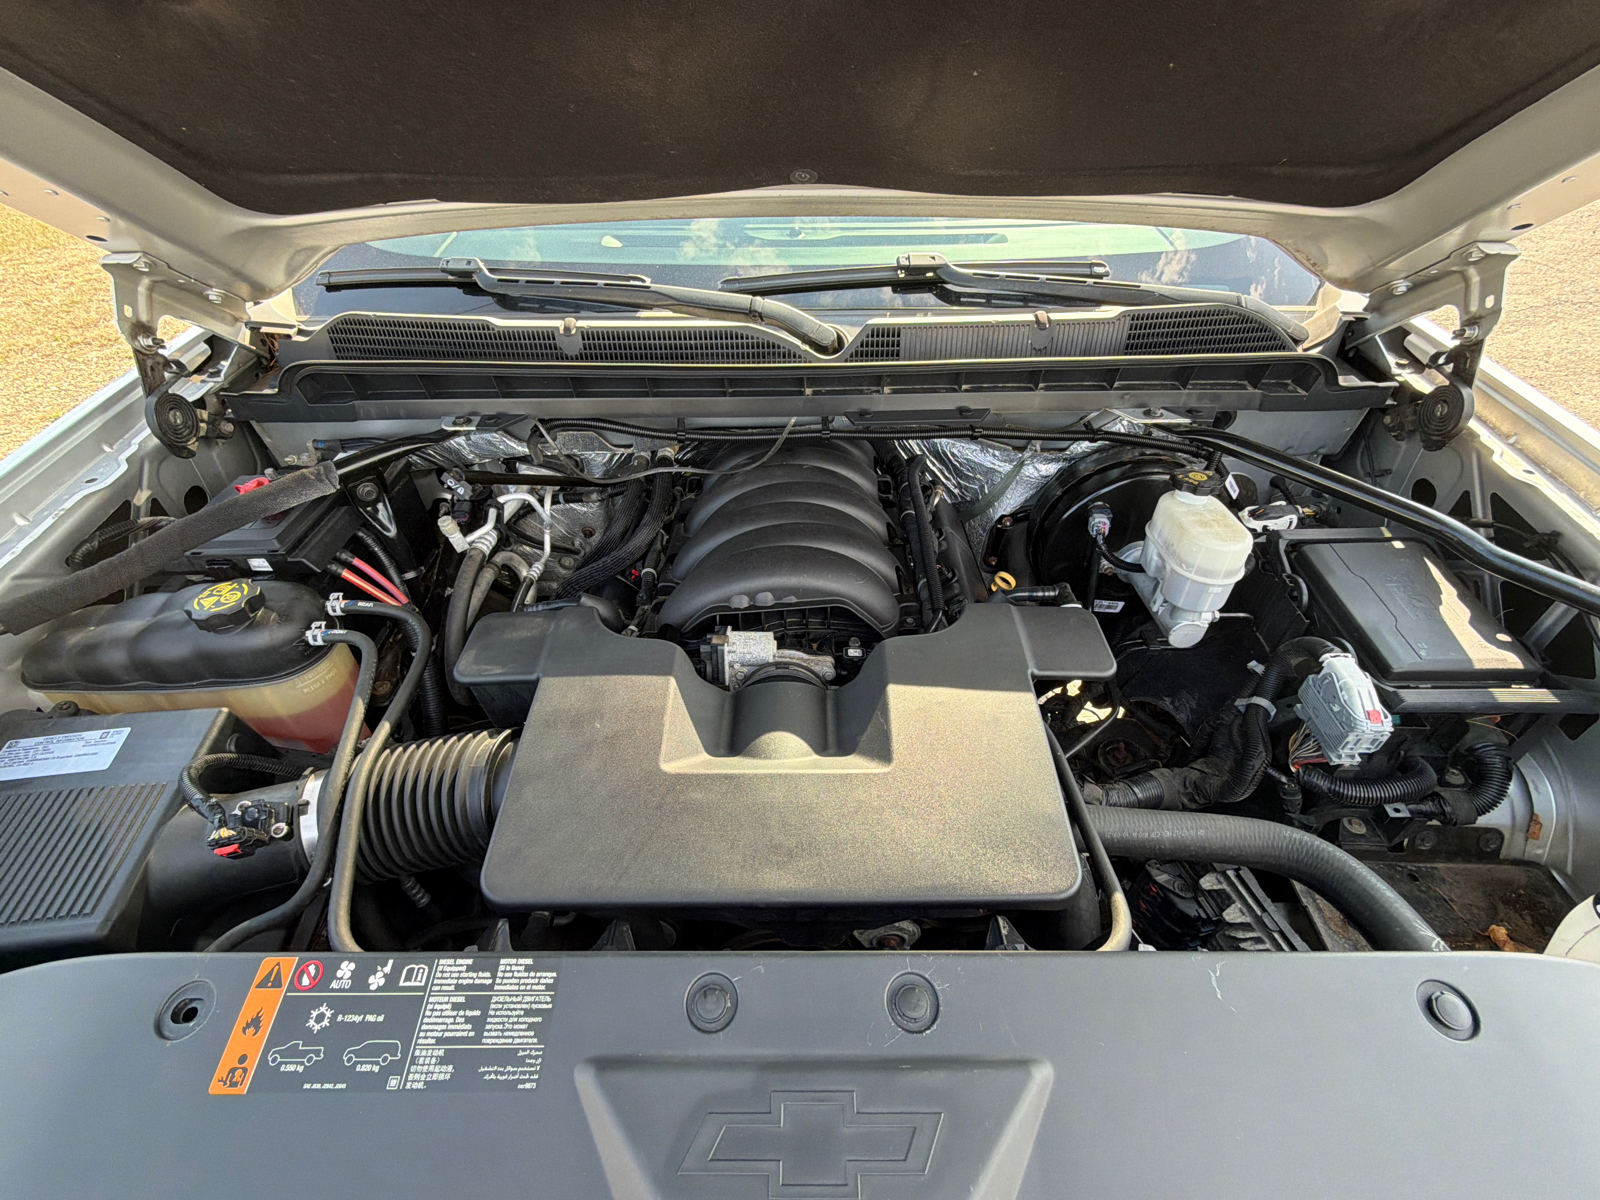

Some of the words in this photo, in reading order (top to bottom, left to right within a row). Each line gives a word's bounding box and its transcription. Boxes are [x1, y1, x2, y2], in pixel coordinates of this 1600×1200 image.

[460, 971, 477, 979] starting
[329, 979, 352, 989] AUTO
[458, 978, 474, 986] engine
[474, 978, 493, 986] damage
[522, 995, 552, 1003] ДВИГАТЕЛЬ
[336, 1014, 364, 1023] R-1234yf
[364, 1014, 377, 1022] PAG
[376, 1014, 385, 1022] oil
[280, 1064, 297, 1072] 0.550
[296, 1064, 305, 1073] kg
[372, 1064, 380, 1073] kg
